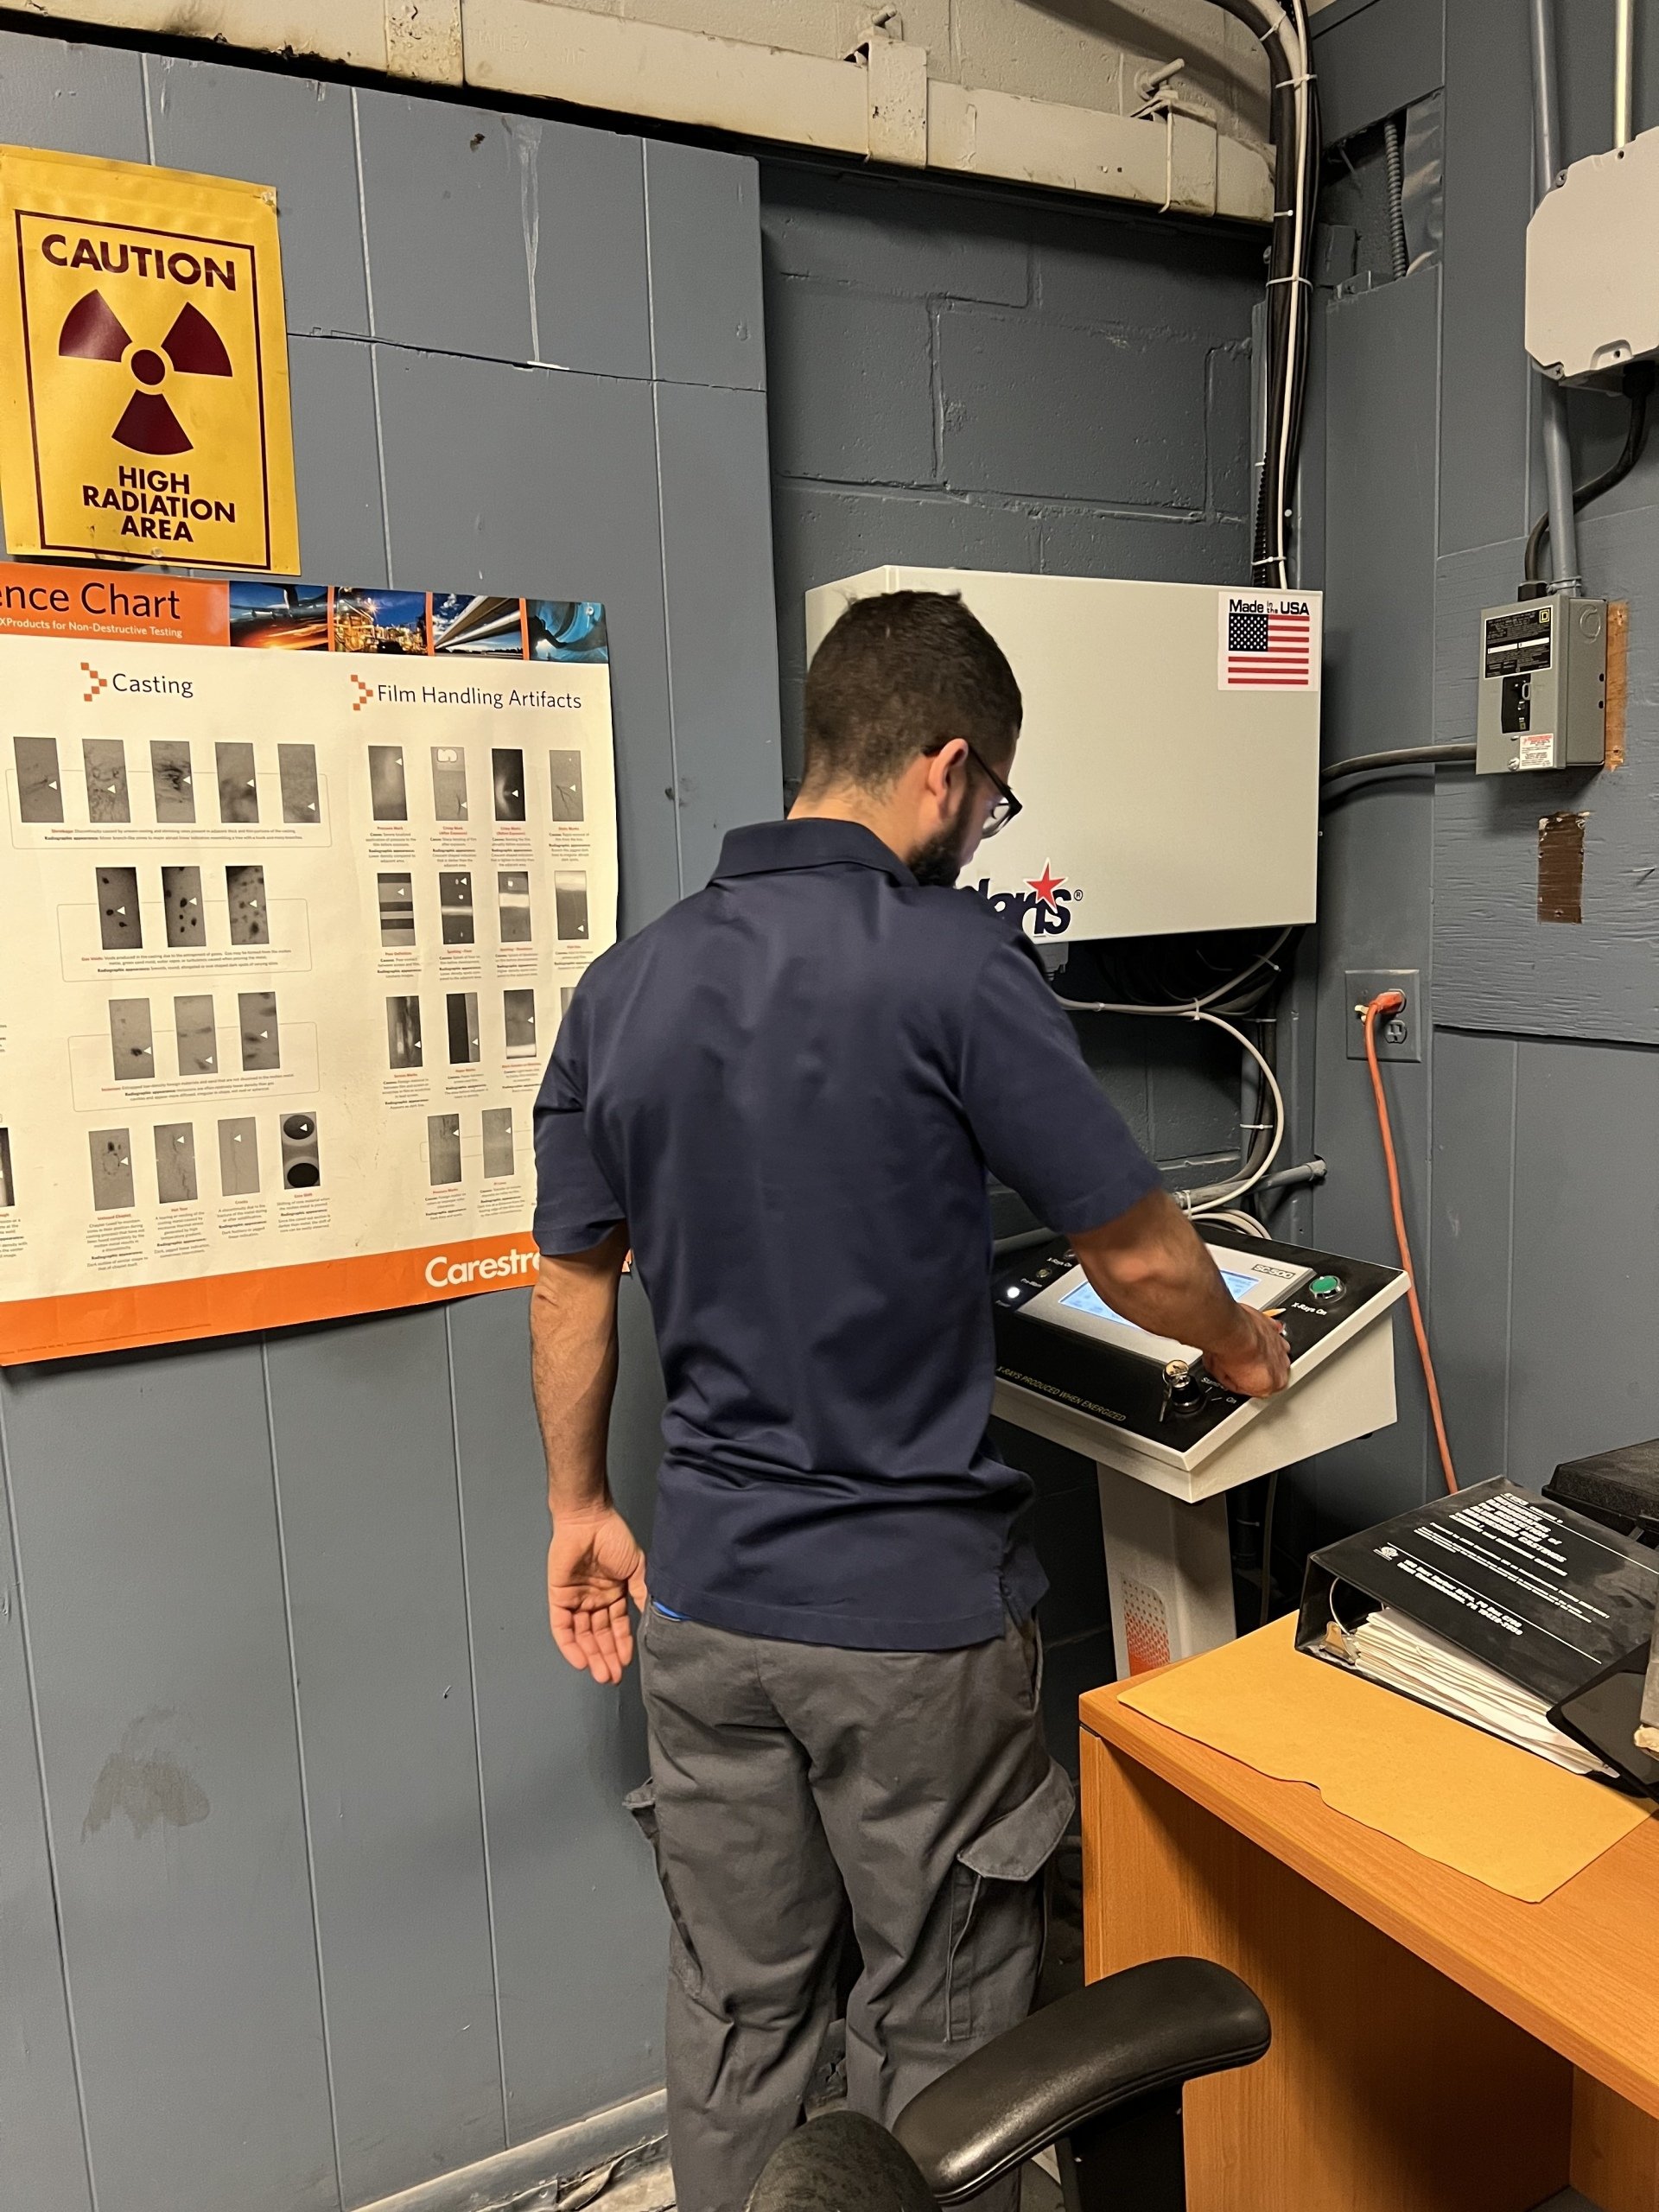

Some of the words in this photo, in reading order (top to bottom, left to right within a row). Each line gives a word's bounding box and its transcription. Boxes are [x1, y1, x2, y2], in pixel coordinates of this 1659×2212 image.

[41, 233, 237, 292] CAUTION
[118, 465, 190, 494] HIGH
[82, 485, 236, 524] RADIATION
[120, 514, 194, 543] AREA
[0, 585, 70, 613] nce
[80, 582, 181, 620] Chart
[1229, 598, 1264, 613] Made
[1281, 601, 1310, 615] USA
[52, 620, 67, 630] for
[68, 621, 148, 635] Non-Destructive
[149, 626, 183, 639] Testing
[112, 673, 194, 698] Casting
[378, 684, 416, 702] Film
[423, 685, 504, 709] Handling
[509, 689, 582, 709] Artifacts
[1291, 1302, 1316, 1313] X-Rays
[996, 1366, 1023, 1380] X-RAYS
[1020, 1376, 1060, 1395] PRODUCED
[1059, 1390, 1084, 1405] WHEN
[1081, 1400, 1127, 1422] ENERGIZED
